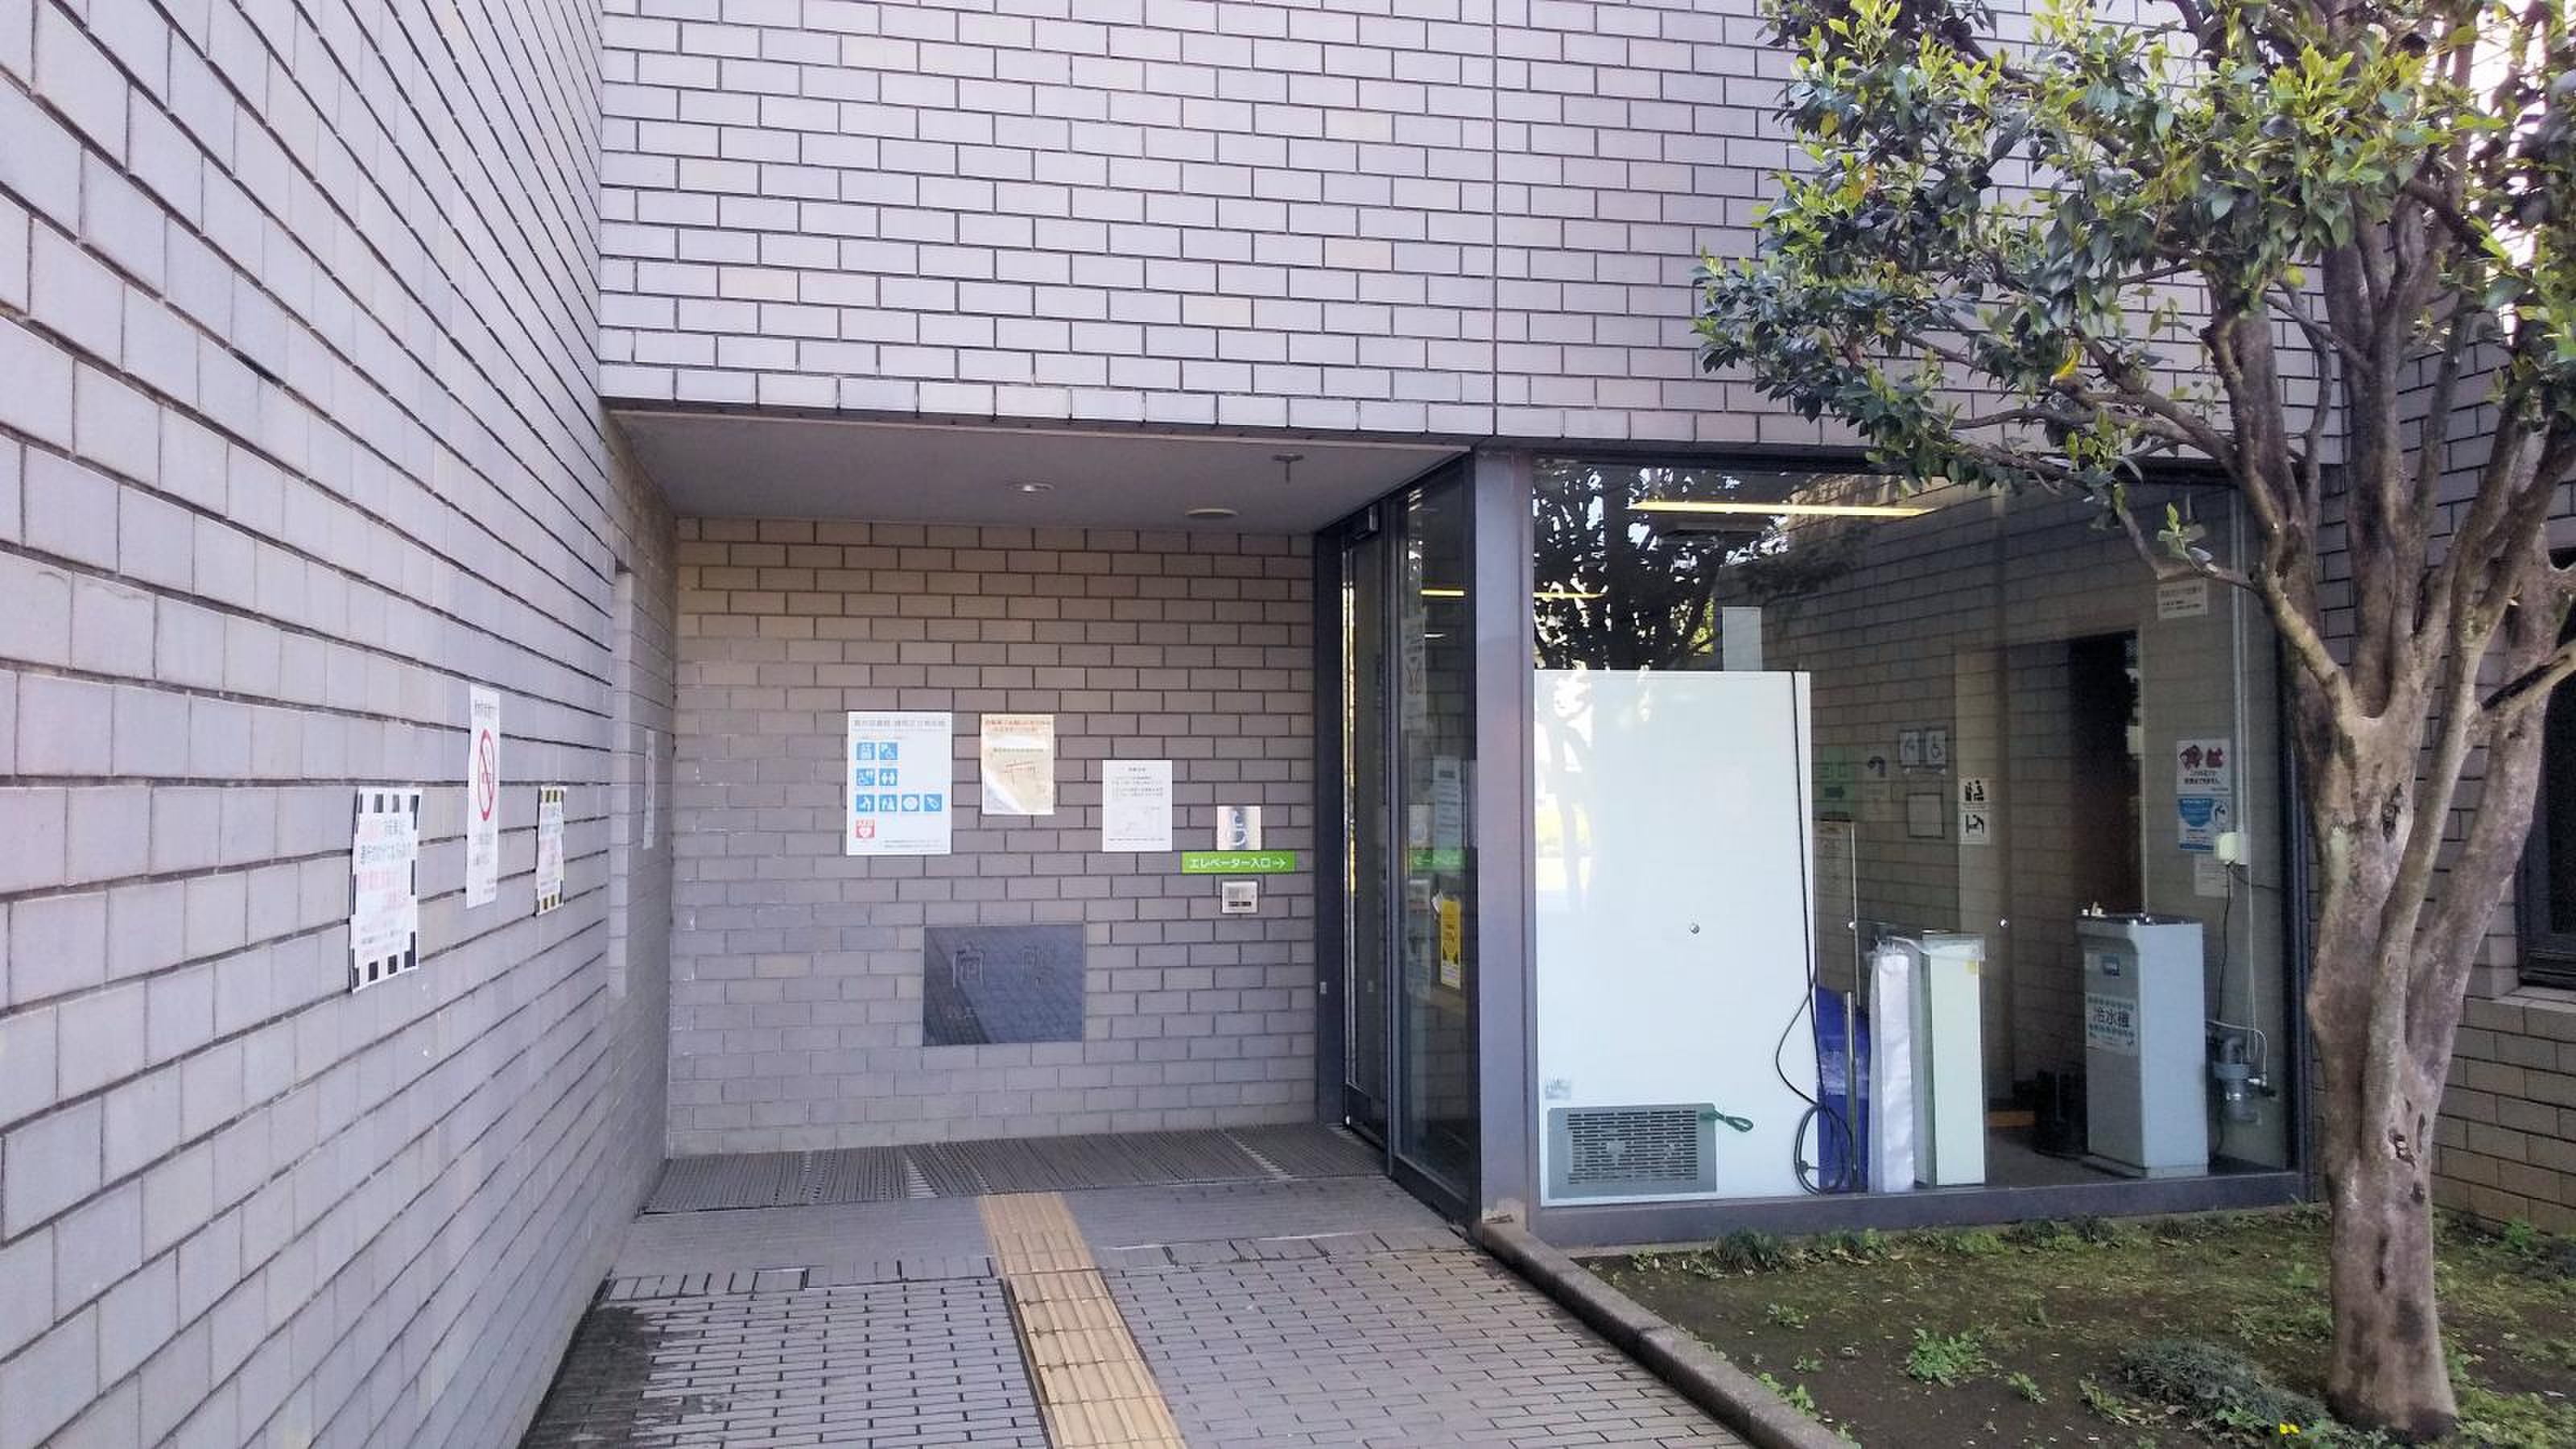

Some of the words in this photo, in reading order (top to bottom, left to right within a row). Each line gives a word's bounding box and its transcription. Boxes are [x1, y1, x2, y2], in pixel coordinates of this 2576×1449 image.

[1190, 857, 1271, 869] エレベーター入口
